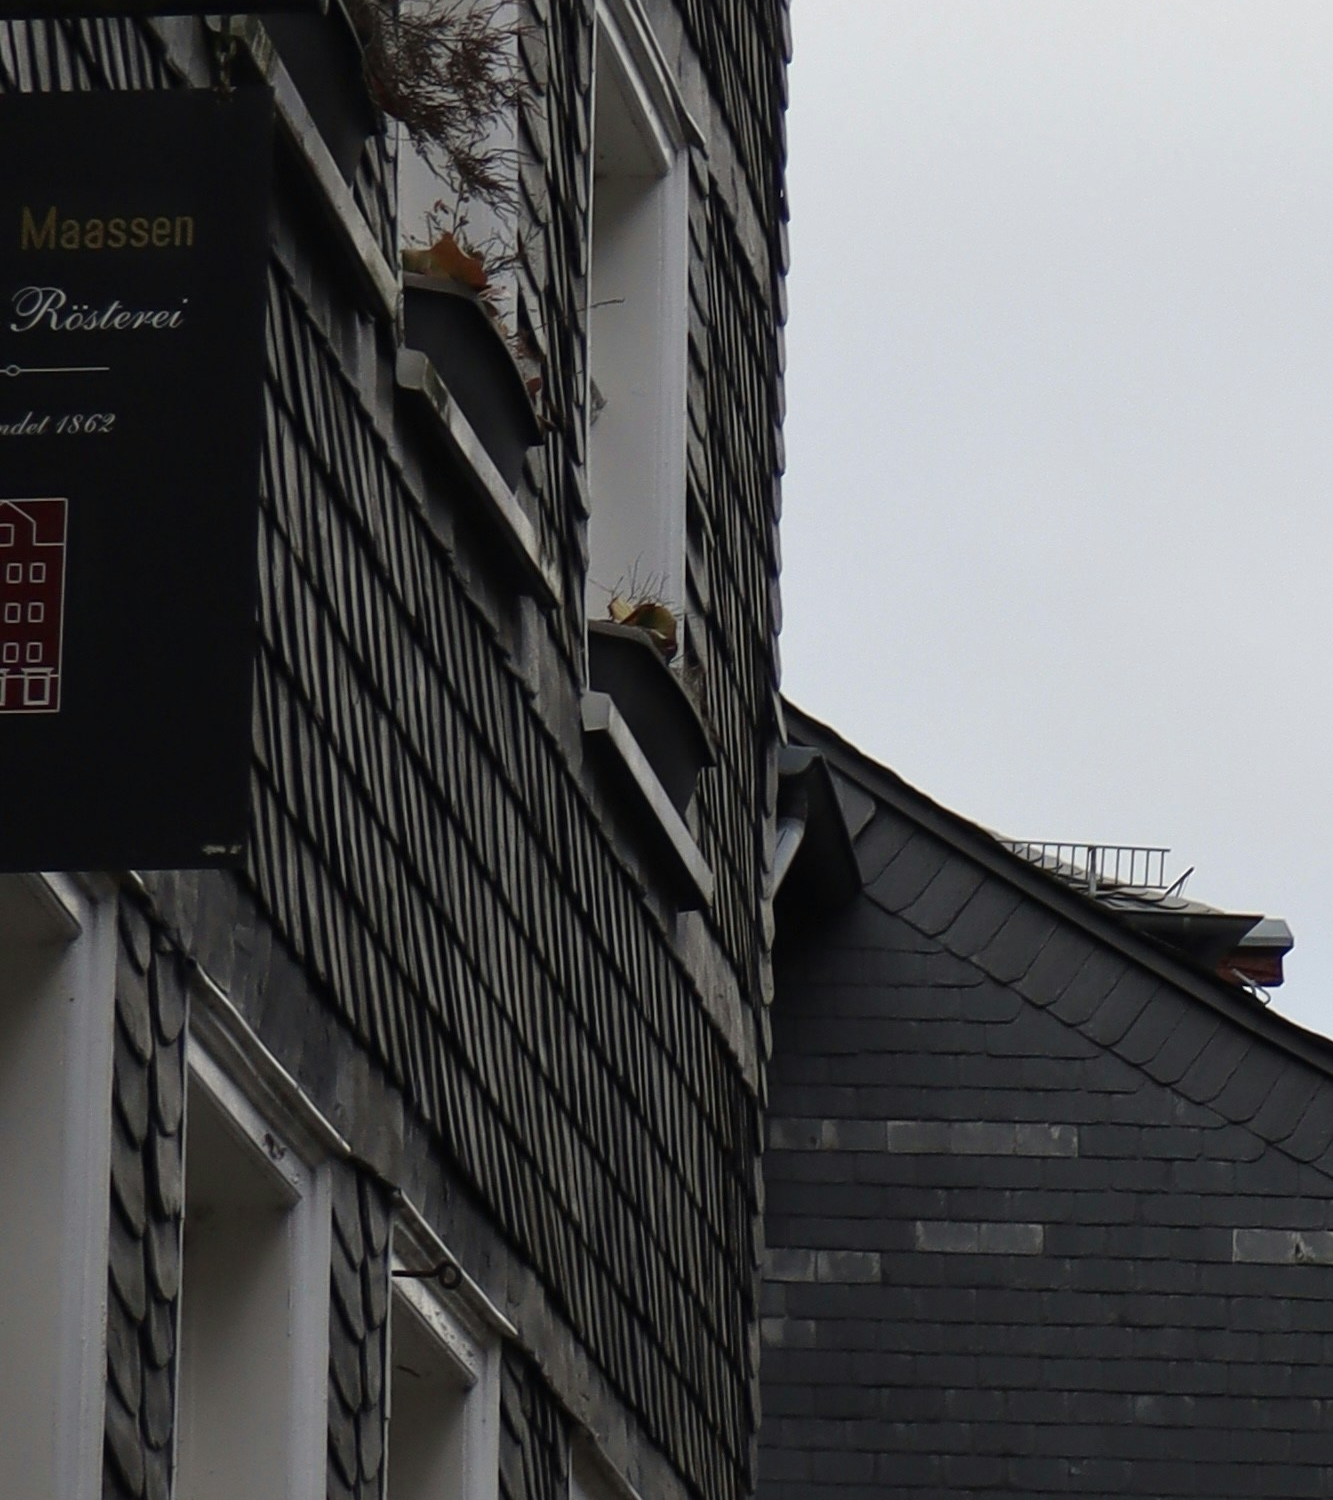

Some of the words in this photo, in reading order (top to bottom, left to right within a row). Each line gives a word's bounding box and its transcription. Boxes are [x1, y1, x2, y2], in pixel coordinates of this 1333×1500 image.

[20, 204, 196, 250] Maassen
[10, 285, 189, 332] Rösterei
[56, 412, 117, 434] 1862
